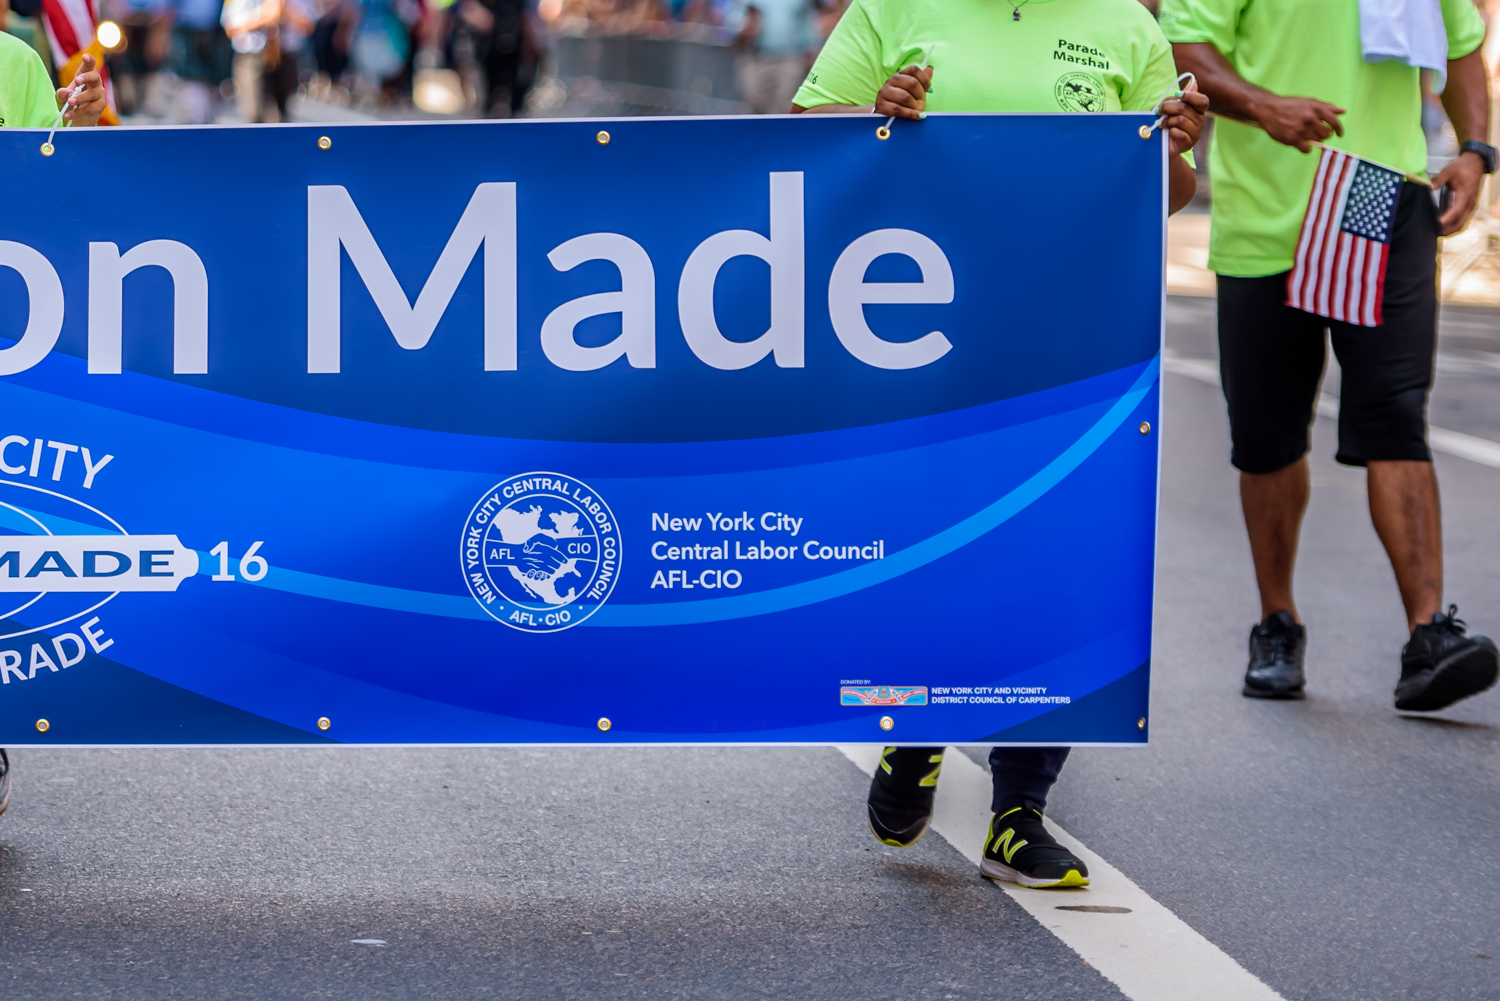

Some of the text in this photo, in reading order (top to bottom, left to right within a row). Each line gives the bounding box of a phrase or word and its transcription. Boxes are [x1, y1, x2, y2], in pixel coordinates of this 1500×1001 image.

[1053, 50, 1109, 70] Marshal
[306, 170, 956, 374] Made
[651, 511, 804, 537] New York City
[466, 478, 617, 605] NEW YORK CITY CENTRAL LABOR COUNCIL
[567, 542, 592, 554] CIO
[650, 539, 885, 561] Central Labor Council
[209, 540, 269, 582] 16
[489, 548, 516, 560] AFL
[650, 569, 743, 589] AFL-CIO
[931, 687, 951, 695] NEW
[951, 687, 974, 695] YORK
[973, 687, 994, 695] CITY
[993, 687, 1013, 695] AND
[1012, 687, 1048, 695] VICINITY
[931, 696, 1072, 704] DISTRICT COUNCIL OF CARPENTERS
